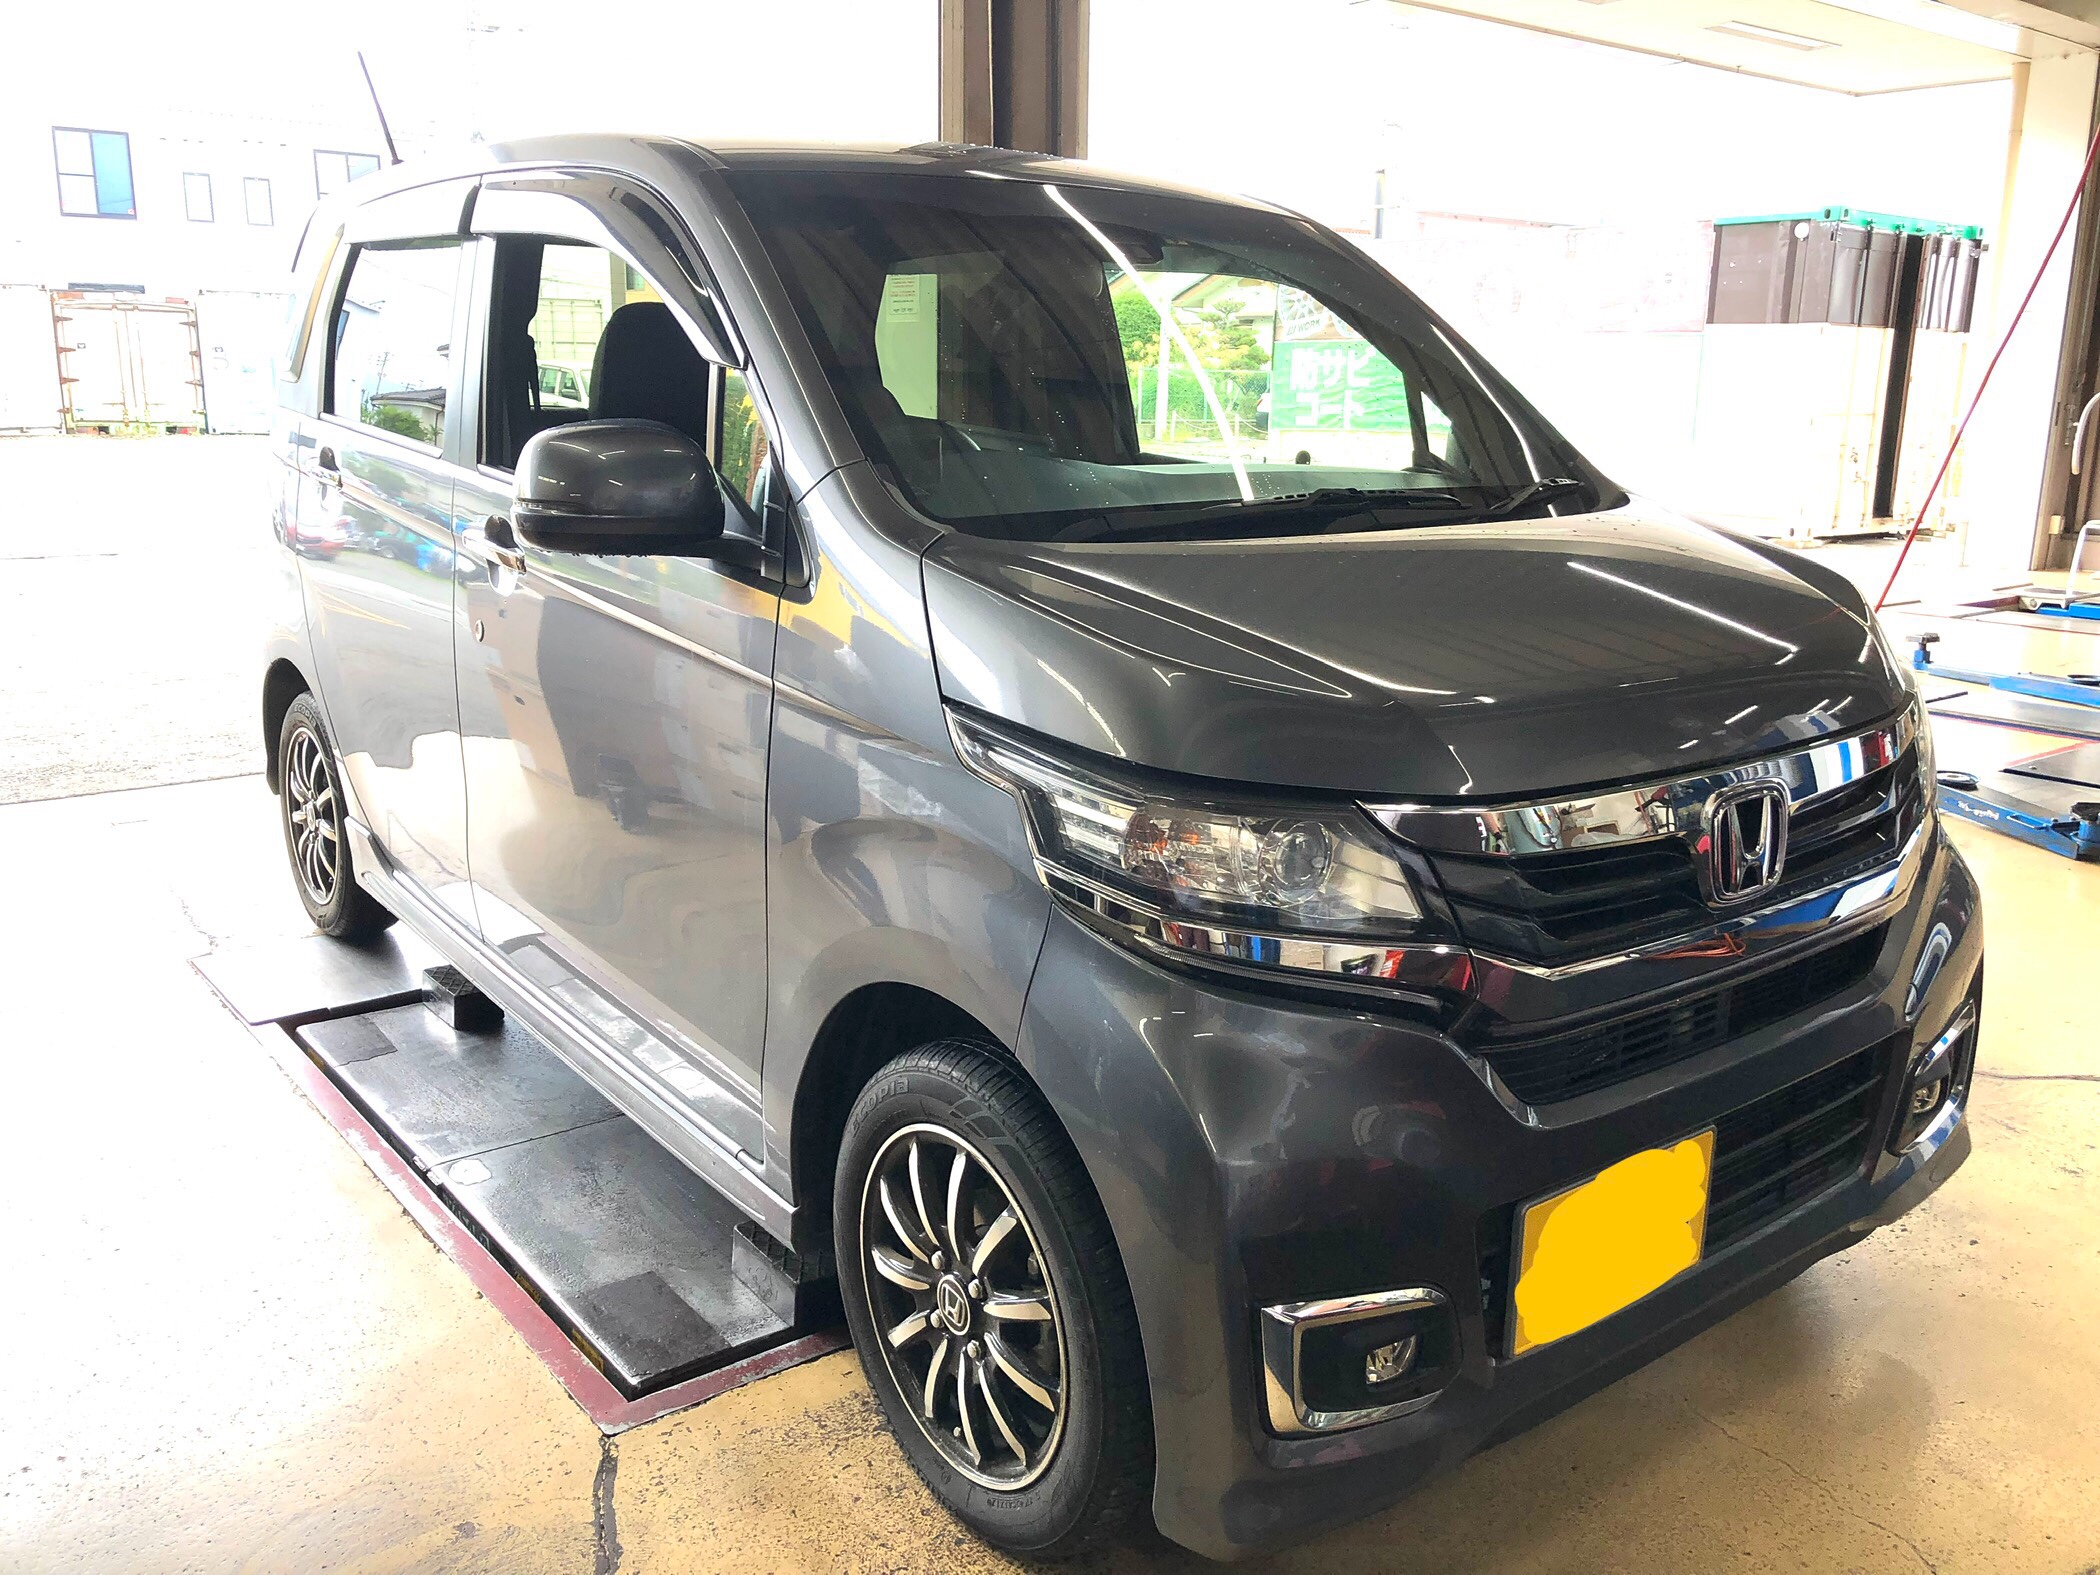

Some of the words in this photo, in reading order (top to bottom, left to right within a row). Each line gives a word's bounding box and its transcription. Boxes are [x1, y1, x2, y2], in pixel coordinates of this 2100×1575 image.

[1290, 347, 1376, 390] 防サビ
[1295, 390, 1365, 429] コート
